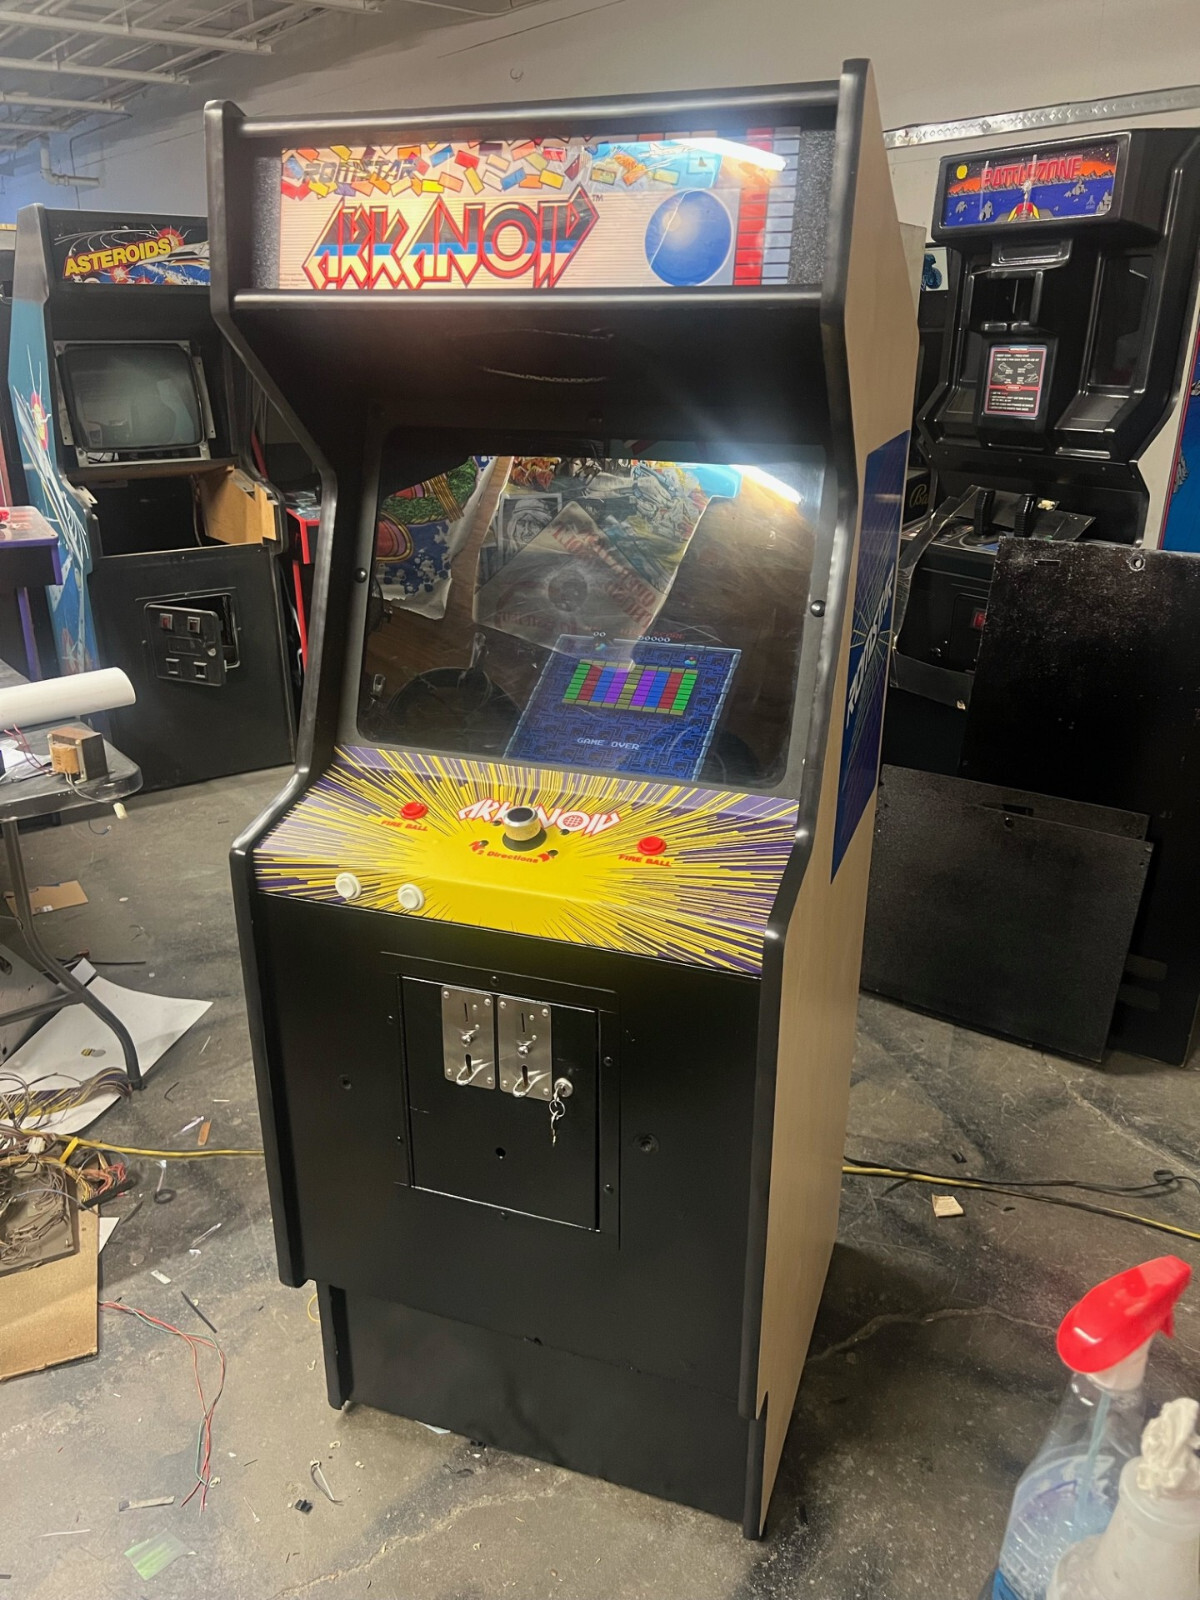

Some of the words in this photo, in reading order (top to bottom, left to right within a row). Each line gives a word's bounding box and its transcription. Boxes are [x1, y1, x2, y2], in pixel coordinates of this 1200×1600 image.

[301, 184, 600, 290] ARKANOID
[63, 237, 172, 278] ASTEROIDS
[577, 737, 605, 746] GAME
[611, 741, 640, 751] OVER
[458, 798, 622, 838] ARKNOID
[380, 820, 401, 829] FIRE
[404, 821, 428, 832] BALL
[487, 850, 539, 864] Directions
[617, 853, 642, 863] FIRE
[645, 858, 672, 867] BALL
